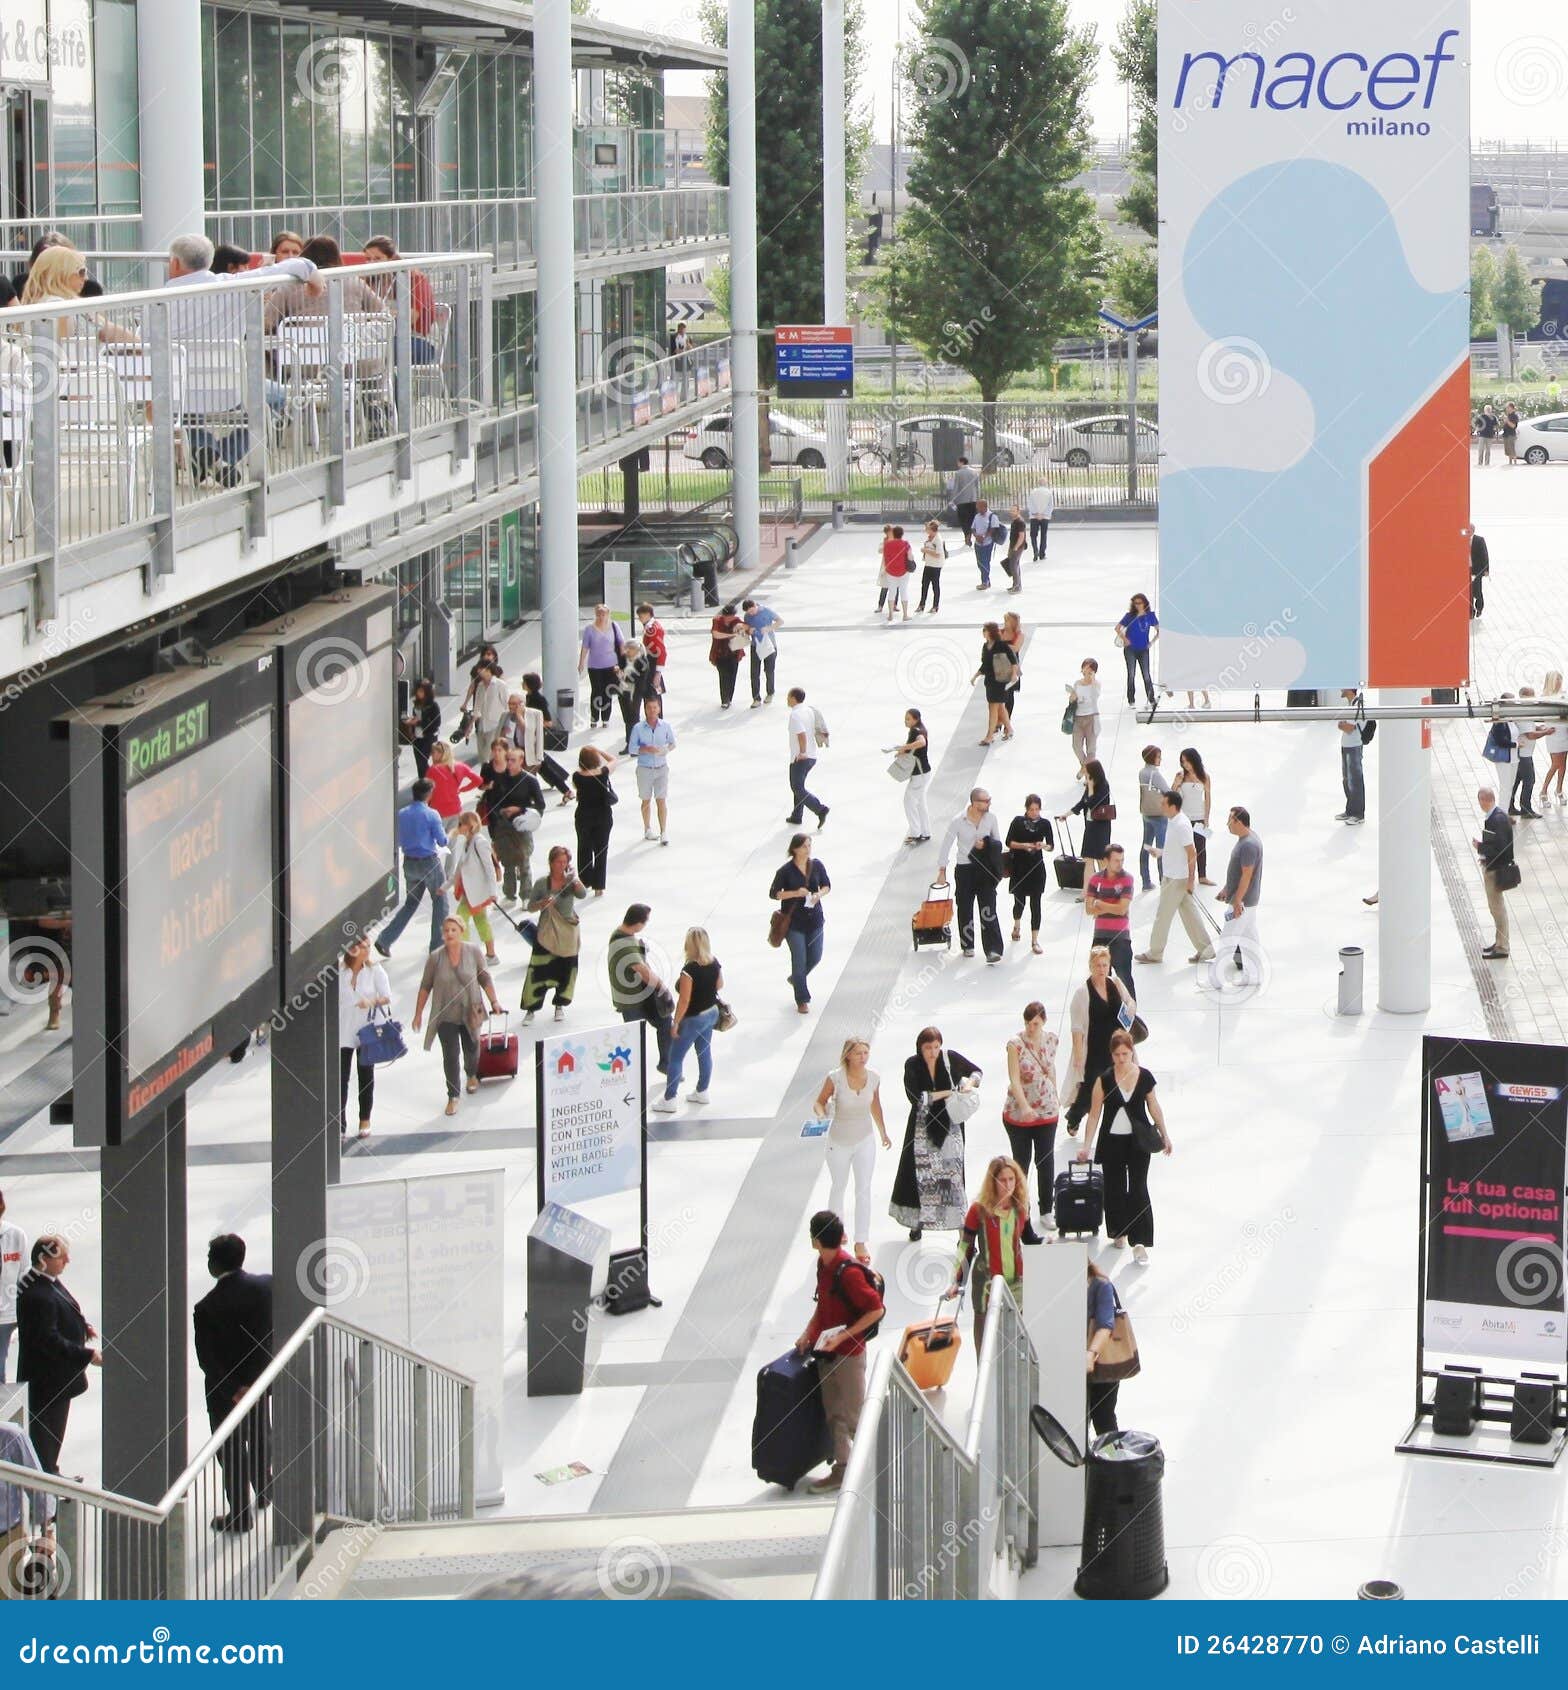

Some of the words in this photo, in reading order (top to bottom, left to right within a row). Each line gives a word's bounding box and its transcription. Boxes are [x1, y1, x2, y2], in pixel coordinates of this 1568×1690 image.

[15, 19, 29, 62] &
[35, 25, 86, 68] Caffè
[1172, 29, 1460, 110] macef
[1346, 117, 1431, 136] milano
[129, 728, 171, 777] Porta
[175, 701, 208, 752] EST
[169, 799, 223, 880] macef
[128, 1033, 213, 1119] fieramilano
[1434, 1077, 1451, 1096] A
[552, 1100, 603, 1118] INGRESSO
[552, 1109, 613, 1130] ESPOSITORI
[552, 1130, 573, 1142] CON
[576, 1120, 620, 1137] TESSERA
[552, 1135, 613, 1155] EXHIBITORS
[552, 1155, 578, 1168] WITH
[582, 1146, 615, 1162] BADGE
[552, 1163, 606, 1182] ENTRANCE
[1447, 1178, 1469, 1194] La
[1476, 1180, 1506, 1197] tua
[1512, 1186, 1556, 1201] casa
[1443, 1196, 1473, 1214] full
[1479, 1203, 1559, 1221] optional
[1481, 1319, 1517, 1330] AbitaMi
